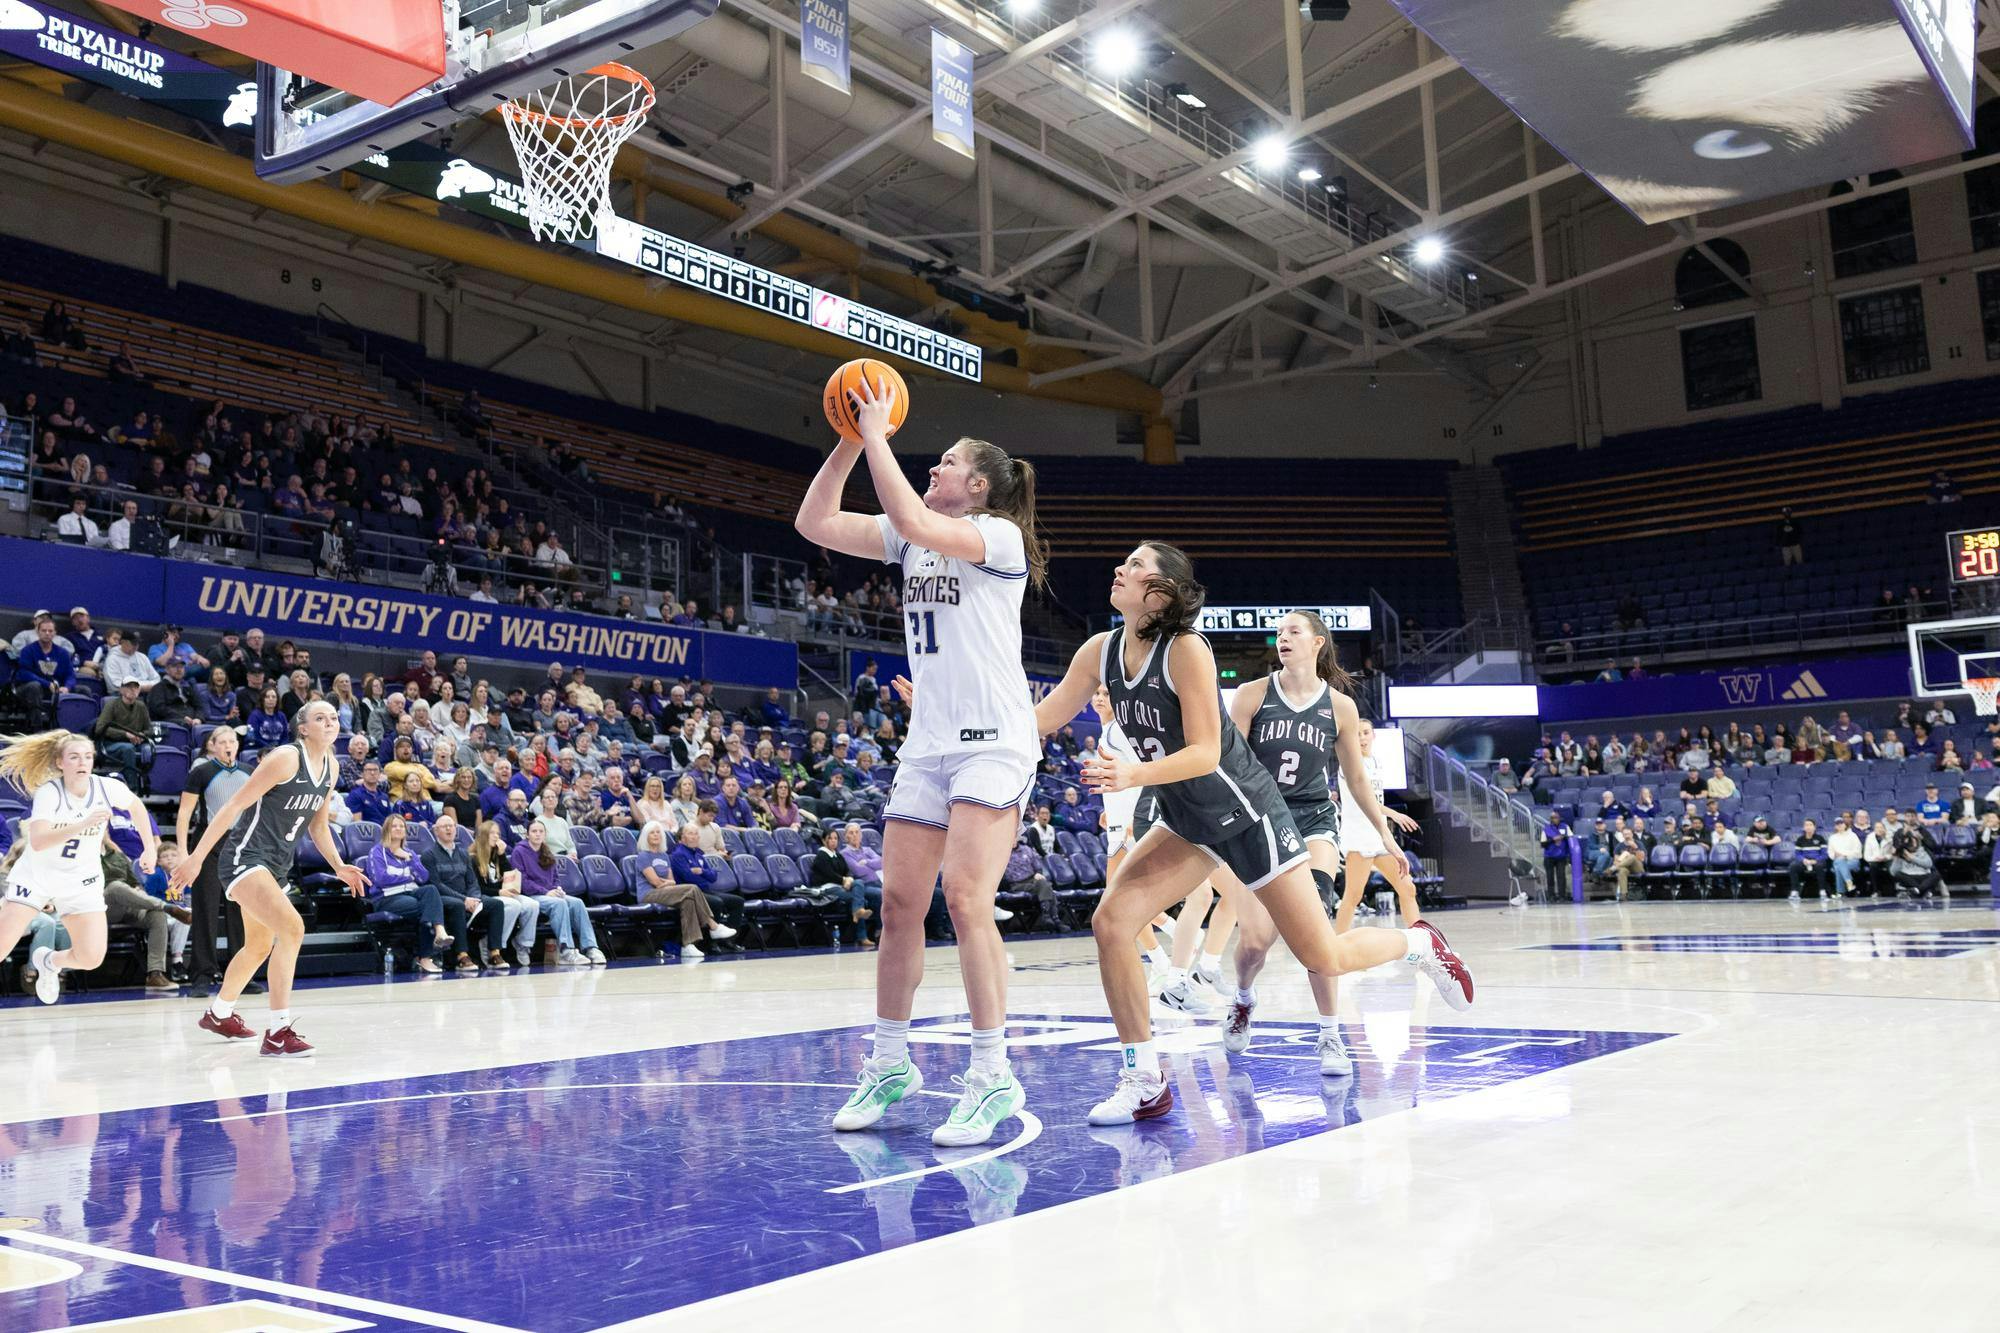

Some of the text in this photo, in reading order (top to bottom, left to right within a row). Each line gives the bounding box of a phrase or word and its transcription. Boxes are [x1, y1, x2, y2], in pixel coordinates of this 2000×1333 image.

[807, 10, 844, 39] FOUR
[48, 15, 165, 73] PUYALLUP
[814, 36, 837, 58] 1953
[37, 33, 163, 88] TRIBE of INDIANS
[935, 68, 971, 96] FINAL
[937, 84, 969, 109] FOUR
[281, 269, 322, 292] 8 9
[735, 281, 745, 297] 3
[758, 288, 766, 304] 1
[778, 295, 786, 311] 1
[796, 301, 805, 317] 0
[868, 327, 878, 342] 0
[886, 334, 896, 347] 0
[903, 340, 912, 353] 4
[936, 351, 945, 366] 2
[951, 355, 960, 371] 0
[1949, 346, 1962, 359] 11
[1443, 424, 1503, 438] 10 11
[1963, 532, 2000, 551] 3:58
[1961, 548, 1999, 576] 20
[903, 575, 960, 606] SKIES
[198, 576, 692, 665] UNIVERSITY OF WASHINGTON
[1205, 617, 1214, 628] 4
[1221, 617, 1228, 628] 1
[1236, 612, 1253, 627] 12
[1338, 615, 1347, 628] 4
[1719, 673, 1762, 704] W
[1134, 699, 1166, 732] GRIZ
[1260, 720, 1327, 752] LADY GRIZ
[1277, 749, 1300, 786] 2
[283, 794, 314, 810] LADY
[61, 839, 80, 859] 2
[16, 884, 31, 897] W
